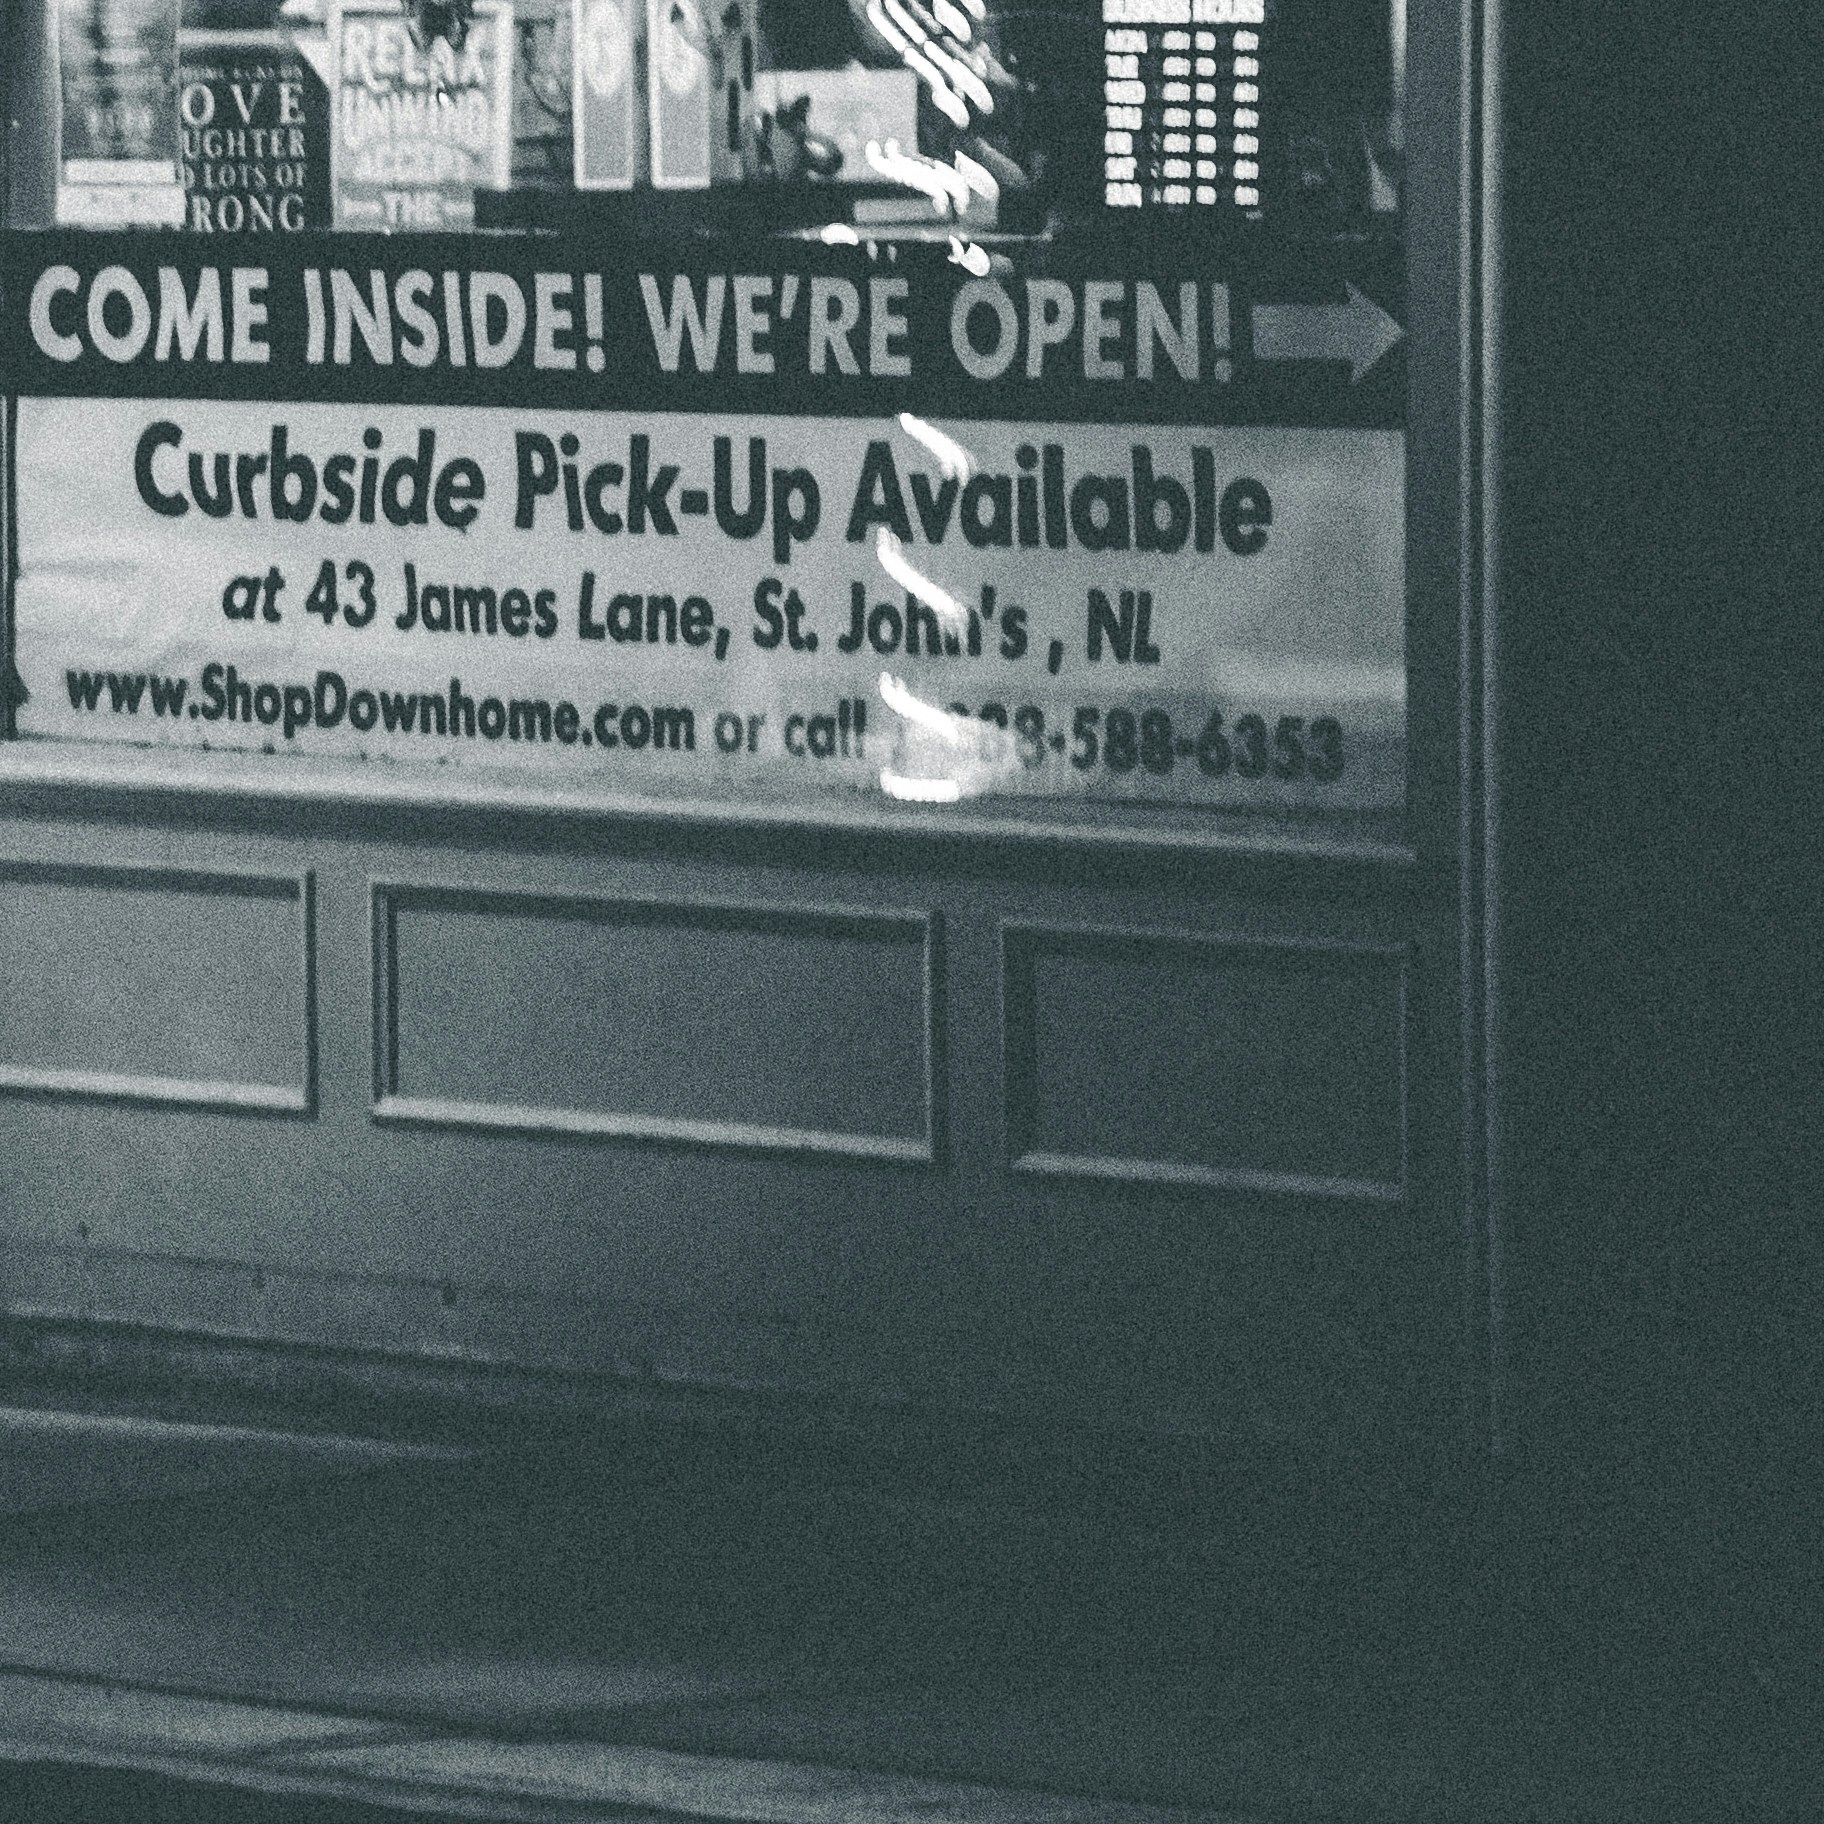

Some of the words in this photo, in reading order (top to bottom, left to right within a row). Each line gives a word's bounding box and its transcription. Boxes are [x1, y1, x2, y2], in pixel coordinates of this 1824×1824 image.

[181, 82, 306, 127] OVE
[344, 21, 487, 92] RELAX
[202, 162, 268, 190] LOTS
[28, 263, 271, 364] COME
[304, 268, 606, 374] INSIDE!
[638, 274, 912, 376] WE'RE
[951, 276, 1233, 383] OPEN!
[134, 420, 487, 533] Curbside
[514, 430, 821, 564] Pick-Up
[847, 440, 1274, 557] Available
[222, 565, 283, 623] at
[305, 559, 377, 629] 43
[396, 562, 558, 638] James
[579, 571, 731, 662] Lane,
[753, 577, 818, 654] St.
[1086, 587, 1160, 665] NL
[65, 662, 697, 753] www.ShopDownhome.com
[713, 710, 764, 753] or
[784, 697, 867, 759] call
